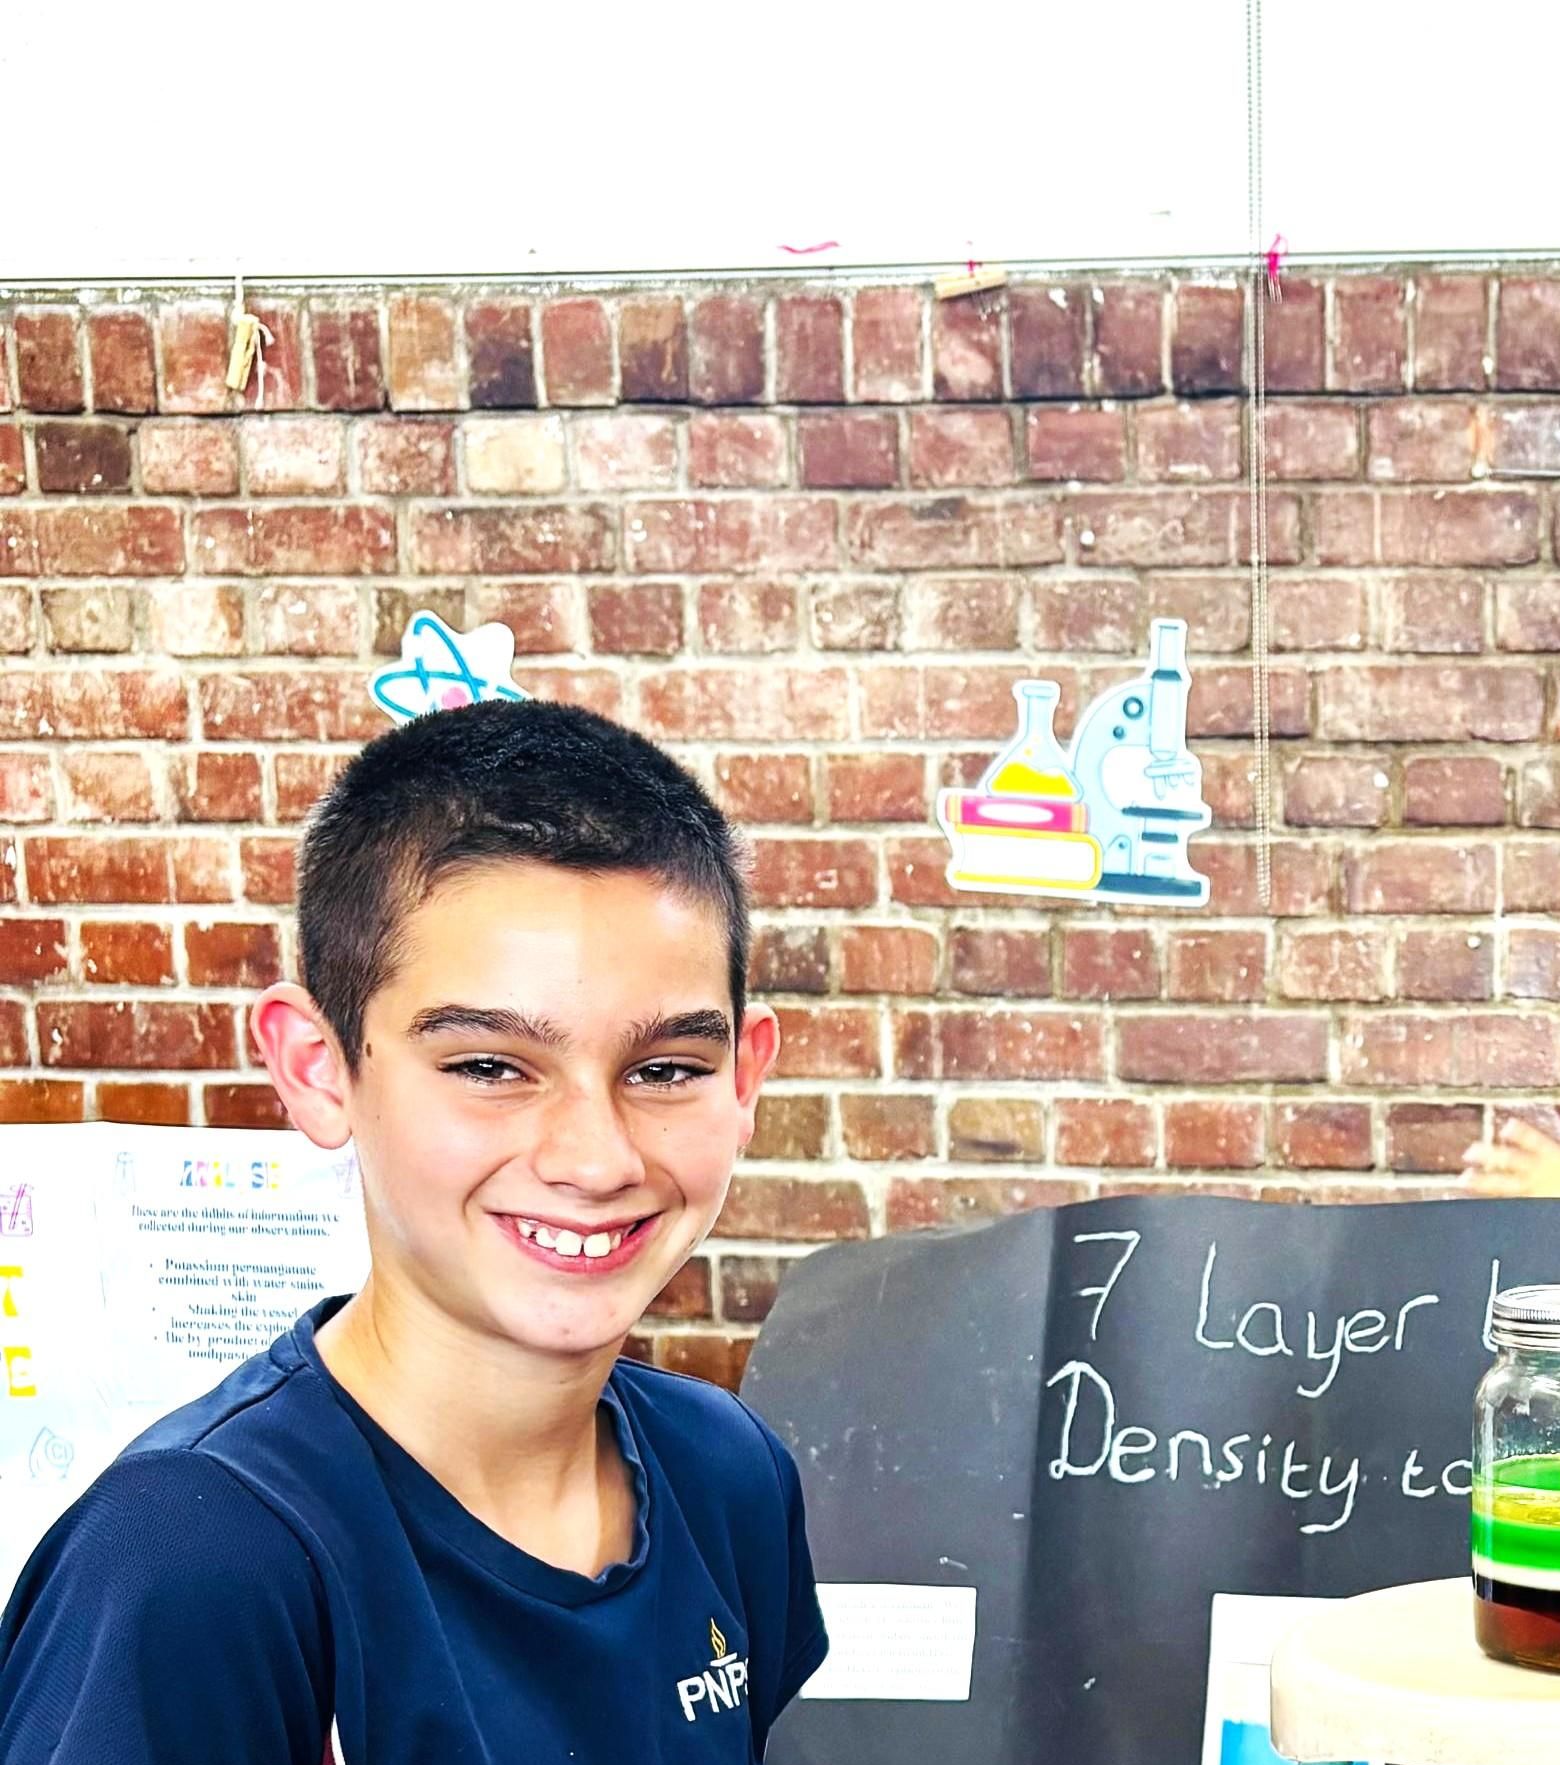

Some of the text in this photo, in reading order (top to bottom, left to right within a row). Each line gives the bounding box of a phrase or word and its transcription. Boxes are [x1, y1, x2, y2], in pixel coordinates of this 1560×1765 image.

[181, 1206, 198, 1219] the
[165, 1257, 229, 1273] Potassium
[158, 1275, 219, 1288] combined
[253, 1278, 286, 1290] water
[241, 1304, 259, 1318] the
[1073, 1229, 1142, 1341] 7
[1195, 1241, 1441, 1397] Layer
[234, 1319, 252, 1332] the
[188, 1348, 250, 1364] toothpast
[1046, 1359, 1366, 1534] Density
[677, 1658, 749, 1722] PNP
